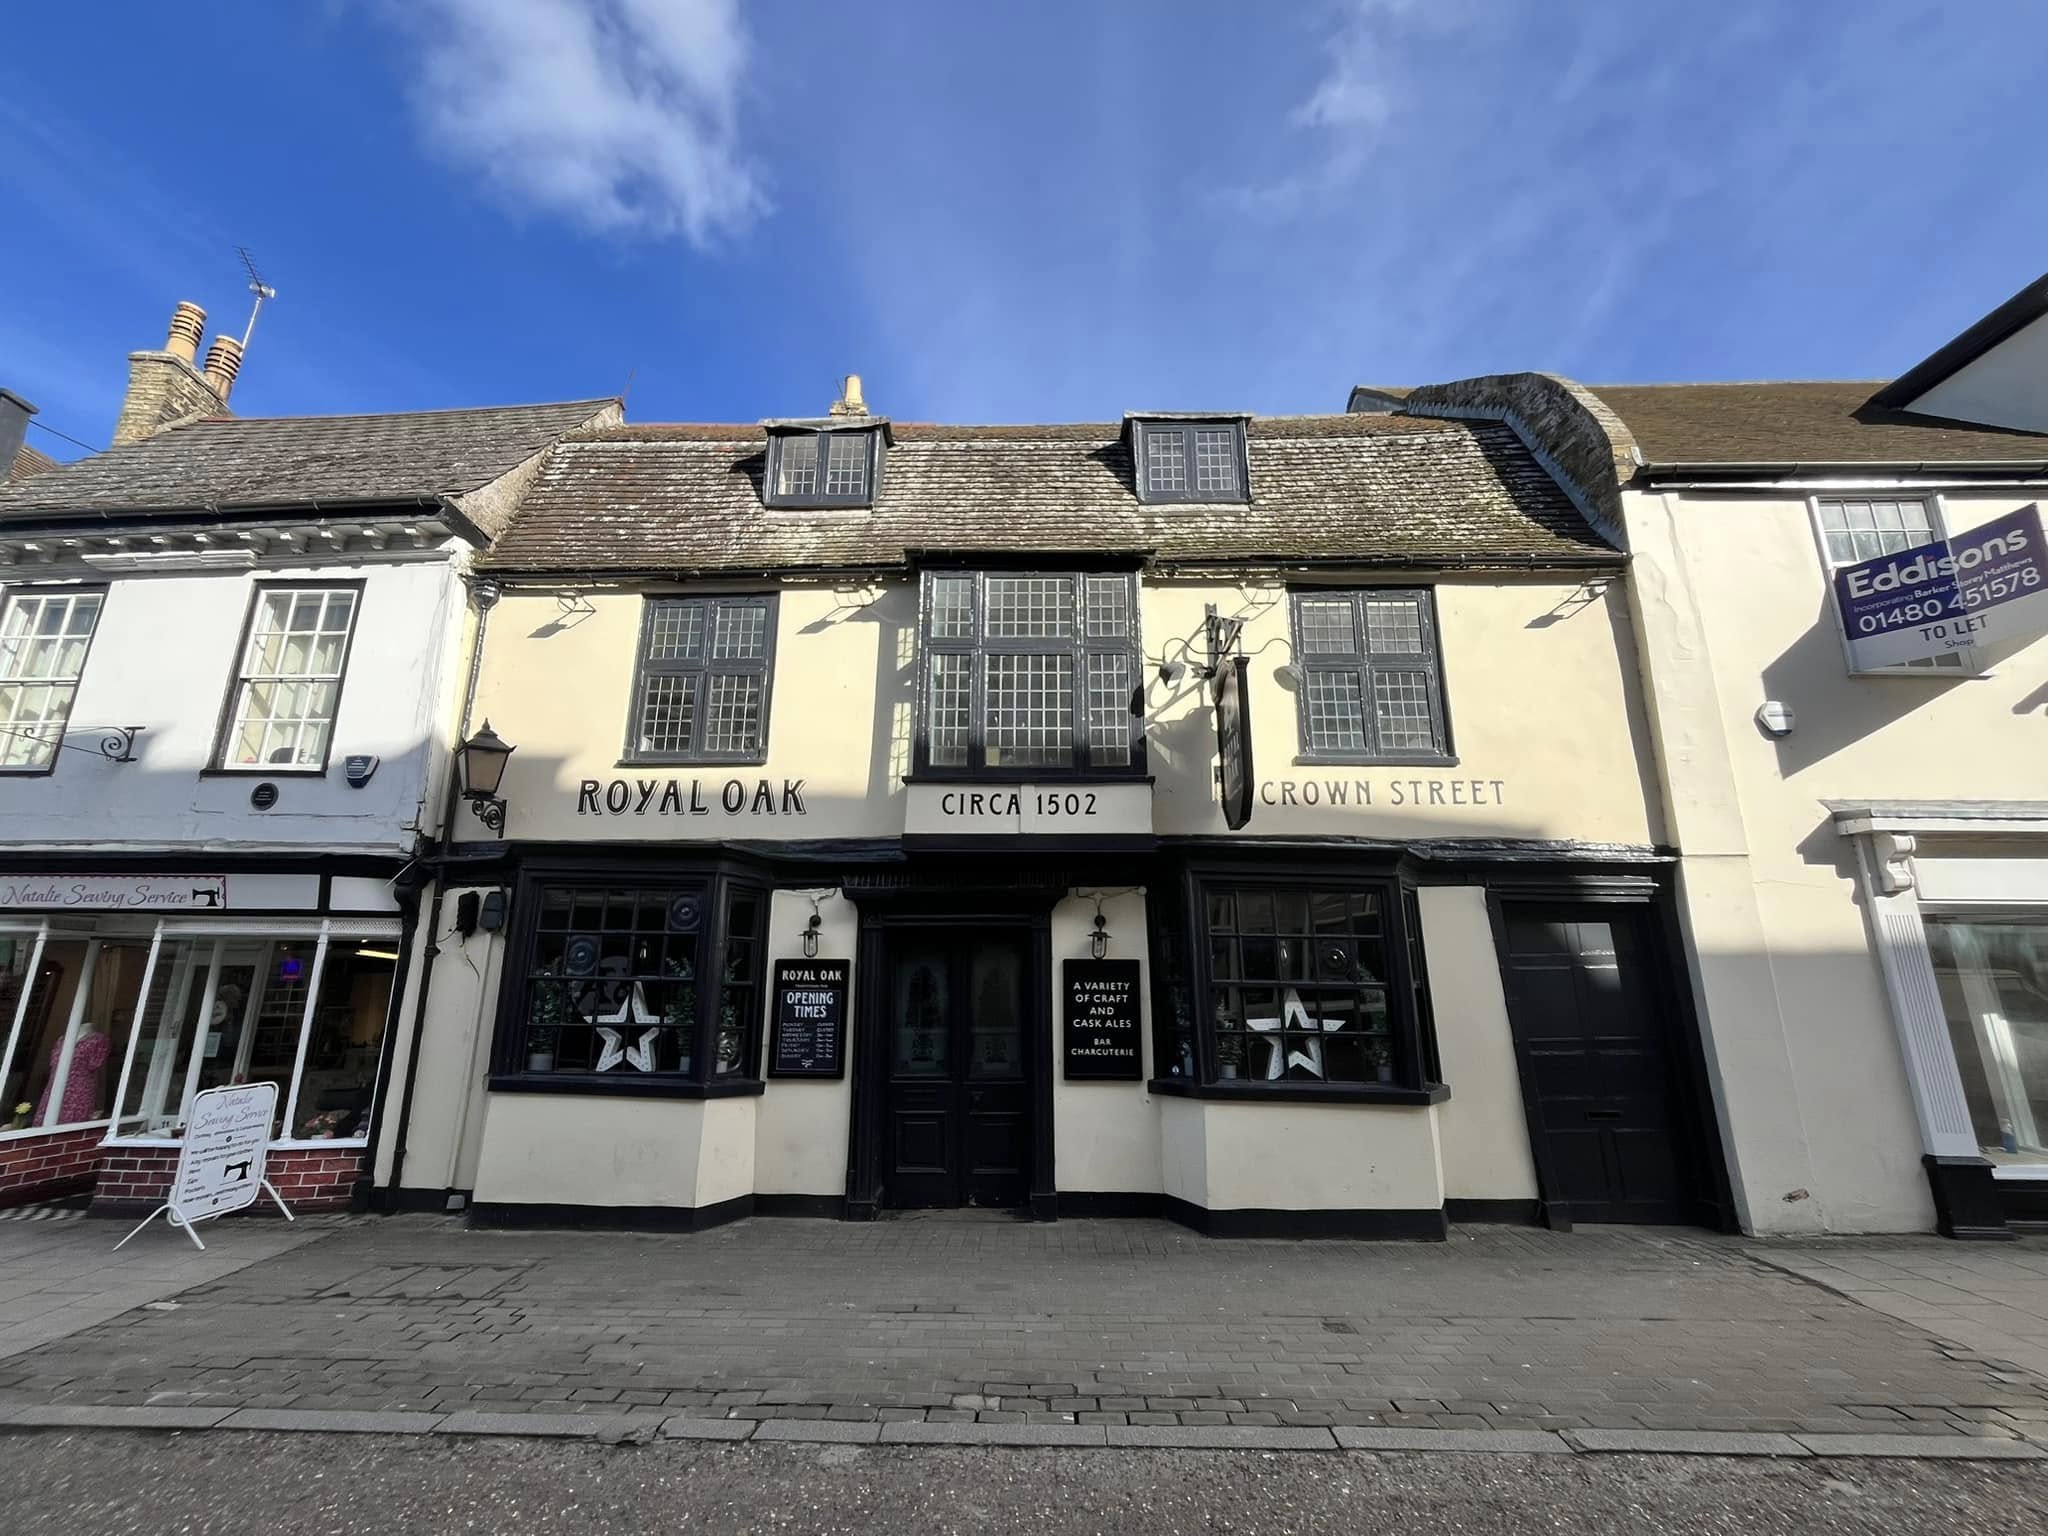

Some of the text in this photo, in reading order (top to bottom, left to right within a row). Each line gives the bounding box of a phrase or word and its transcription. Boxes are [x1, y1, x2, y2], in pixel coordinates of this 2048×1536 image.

[1846, 529, 2028, 599] Eddisons
[1853, 557, 2033, 613] Incorporating Barker Storey Matthews
[1858, 566, 2041, 632] 01480 451578
[1919, 614, 1989, 642] TO LET
[1944, 638, 1974, 649] Shop
[577, 779, 808, 816] ROYAL OAK
[1260, 779, 1505, 806] CROWN STREET
[942, 793, 1097, 815] CIRCA 1502
[2, 884, 188, 908] Natalie Sewing Service
[782, 970, 842, 981] ROYAL OAK
[1073, 982, 1130, 990] A VARIETY
[786, 992, 834, 1004] OPENING
[1075, 994, 1129, 1003] OF CRAFT
[794, 1005, 827, 1018] TIMES
[1089, 1007, 1114, 1015] AND
[1073, 1019, 1132, 1028] CASK ALES
[1094, 1038, 1111, 1046] BAR
[1071, 1048, 1134, 1056] CHARCUTERIE
